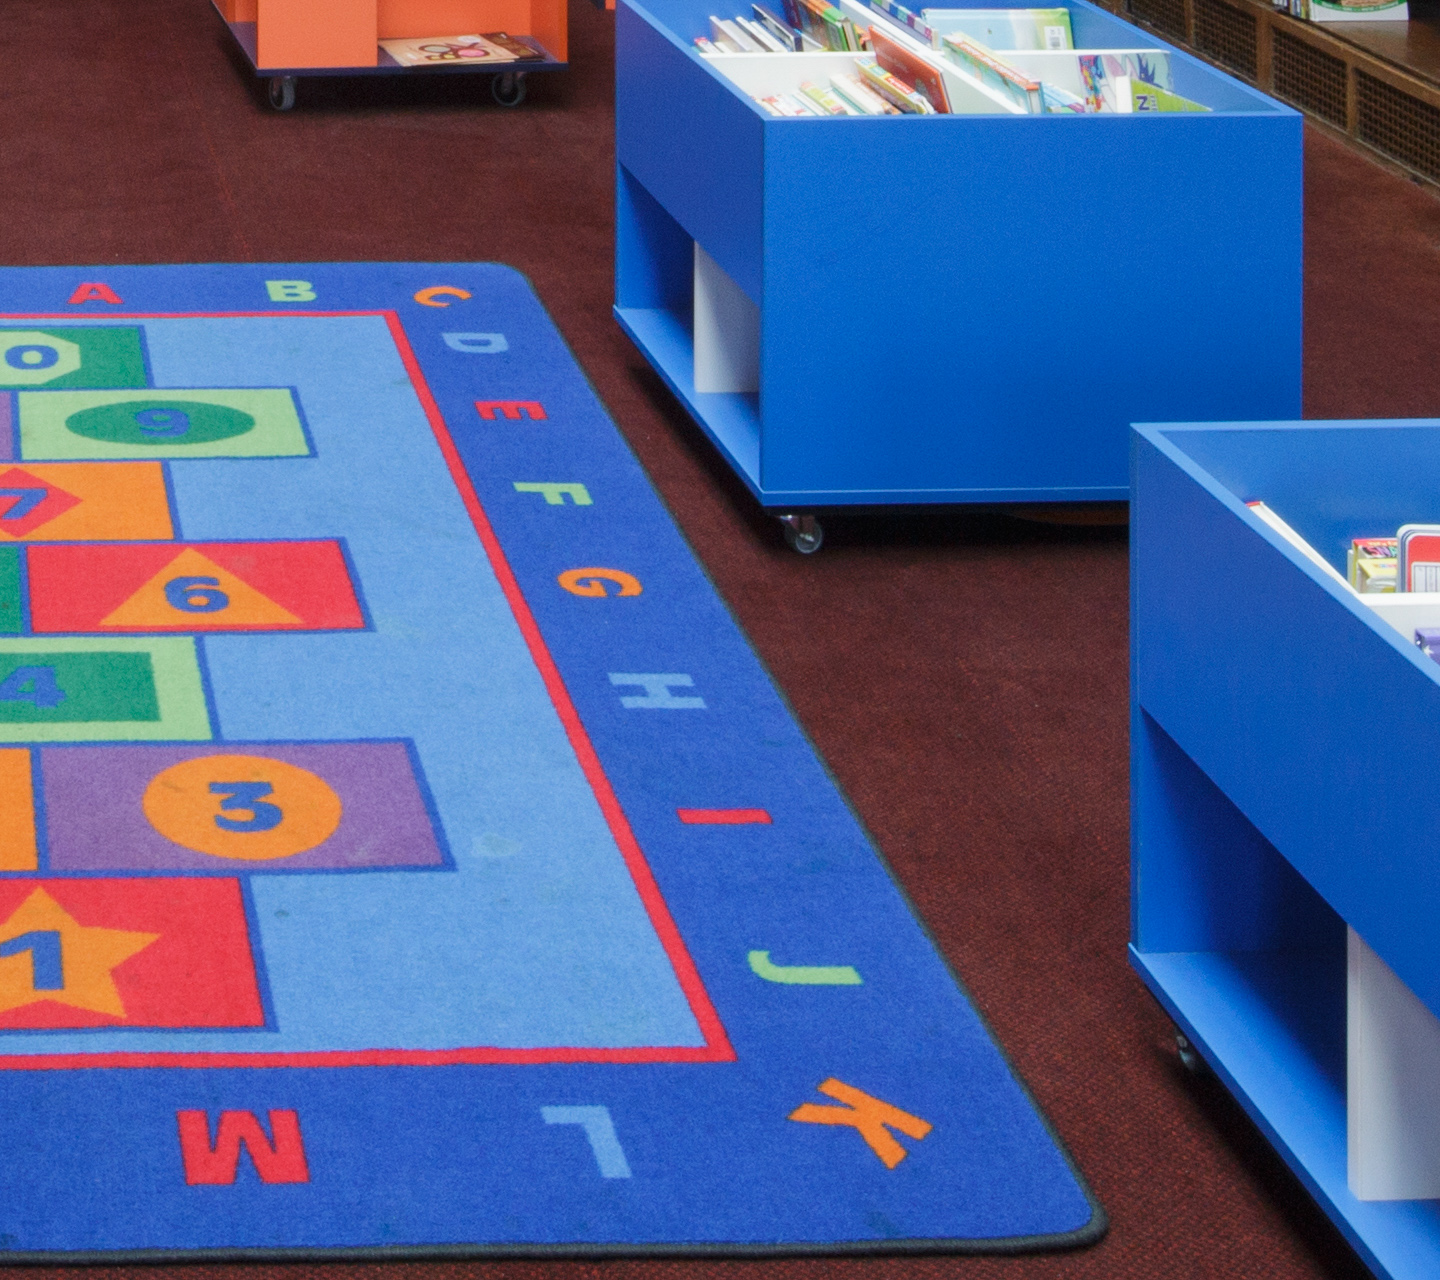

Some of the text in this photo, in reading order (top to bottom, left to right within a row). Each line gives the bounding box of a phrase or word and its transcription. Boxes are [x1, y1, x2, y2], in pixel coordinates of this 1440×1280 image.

[67, 282, 121, 304] A
[265, 279, 318, 303] B
[413, 285, 472, 307] C
[441, 331, 509, 356] D
[135, 407, 190, 438] 9
[474, 400, 547, 422] E
[514, 481, 592, 507] F
[165, 576, 229, 614] 6
[557, 566, 624, 600] G
[610, 671, 706, 713] H
[209, 777, 284, 834] 3
[676, 807, 772, 827] I
[747, 948, 863, 989] J
[785, 1077, 934, 1168] K
[176, 1108, 310, 1186] M
[540, 1105, 633, 1180] L
